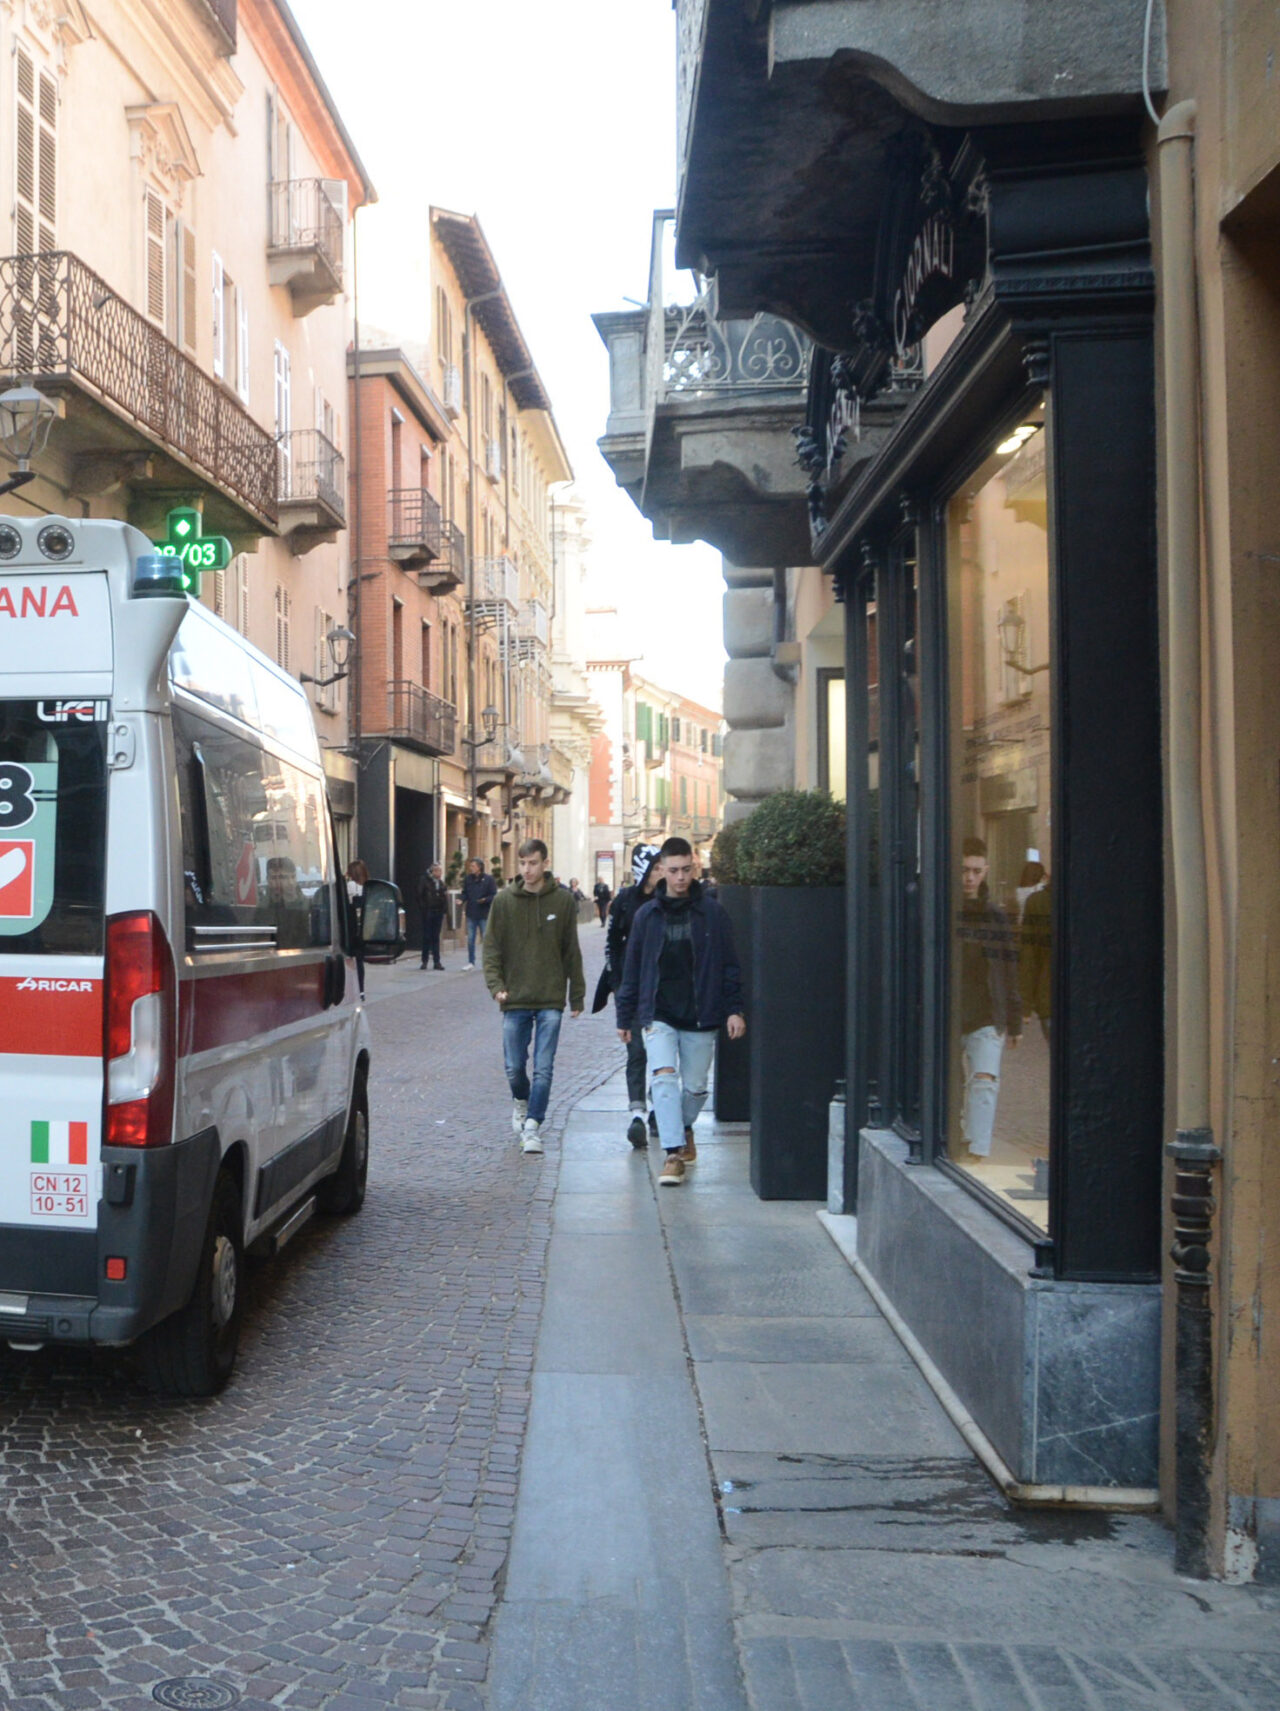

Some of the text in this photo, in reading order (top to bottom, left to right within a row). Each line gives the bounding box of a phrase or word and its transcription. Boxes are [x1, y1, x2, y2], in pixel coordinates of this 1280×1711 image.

[16, 977, 93, 993] ARICAR
[33, 1176, 81, 1193] CN 12
